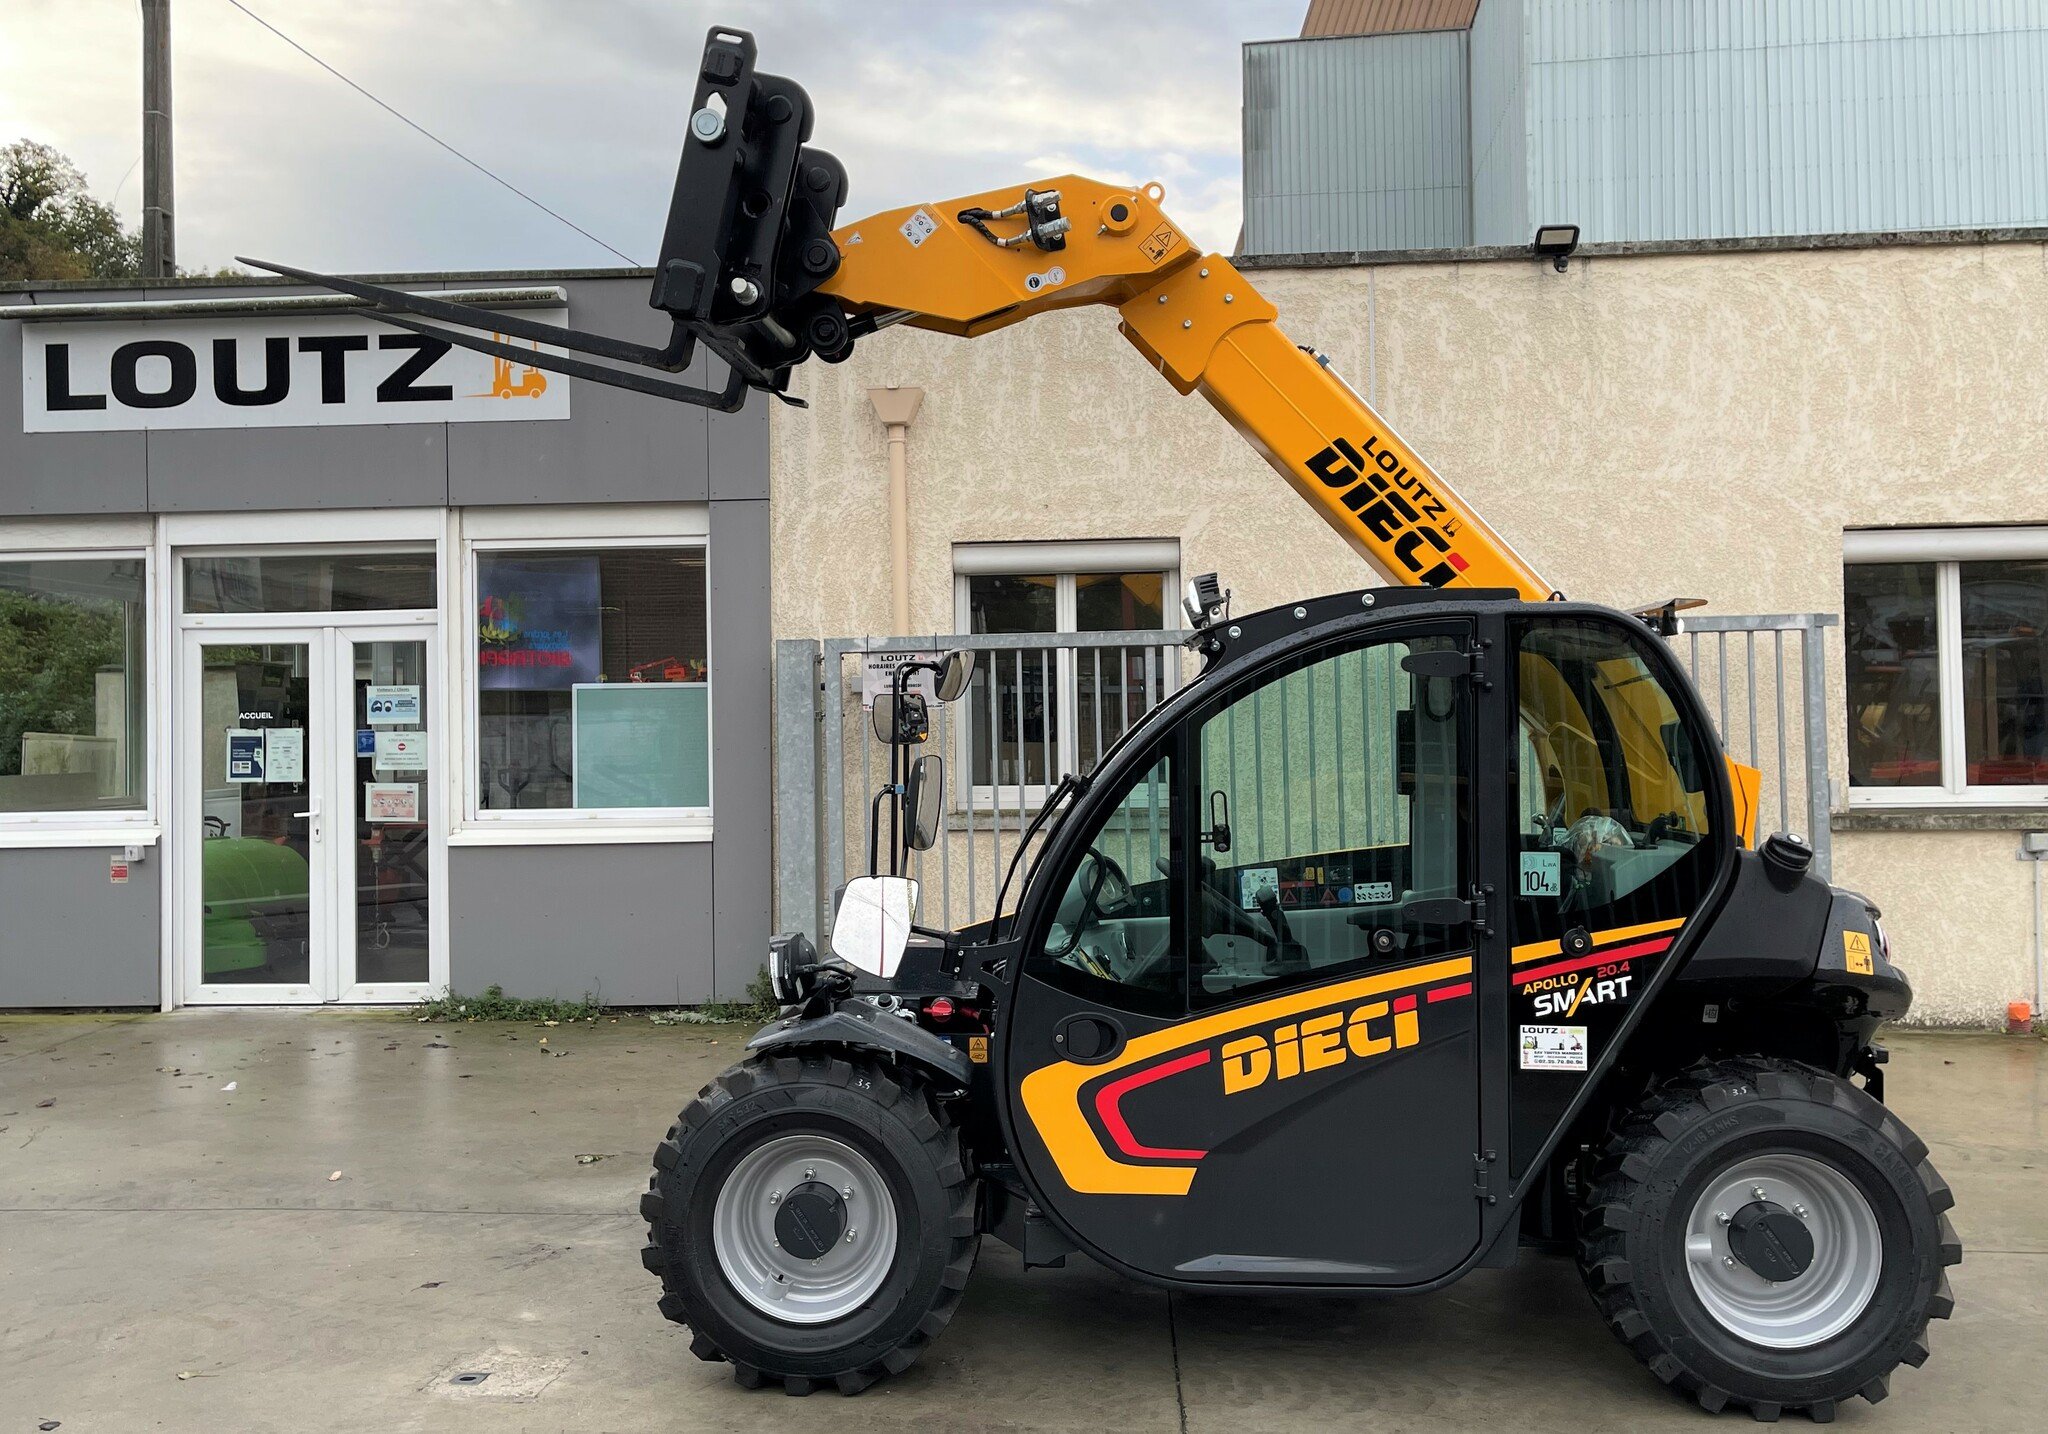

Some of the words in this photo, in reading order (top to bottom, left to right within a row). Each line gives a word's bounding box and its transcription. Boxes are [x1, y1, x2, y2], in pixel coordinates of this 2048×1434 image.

[45, 334, 453, 411] LOUTZ
[1361, 435, 1448, 522] LOUTZ
[1304, 437, 1471, 590] DIECI
[880, 654, 916, 662] LOUTZ
[239, 712, 273, 720] ACCUEIL
[1523, 870, 1550, 892] 104
[1597, 960, 1630, 978] 20.4
[1522, 973, 1579, 995] APOLLO
[1533, 975, 1633, 1018] SMART
[1522, 1026, 1559, 1034] LOUTZ
[1221, 994, 1420, 1096] DIECI
[1732, 1085, 1747, 1097] 3.5
